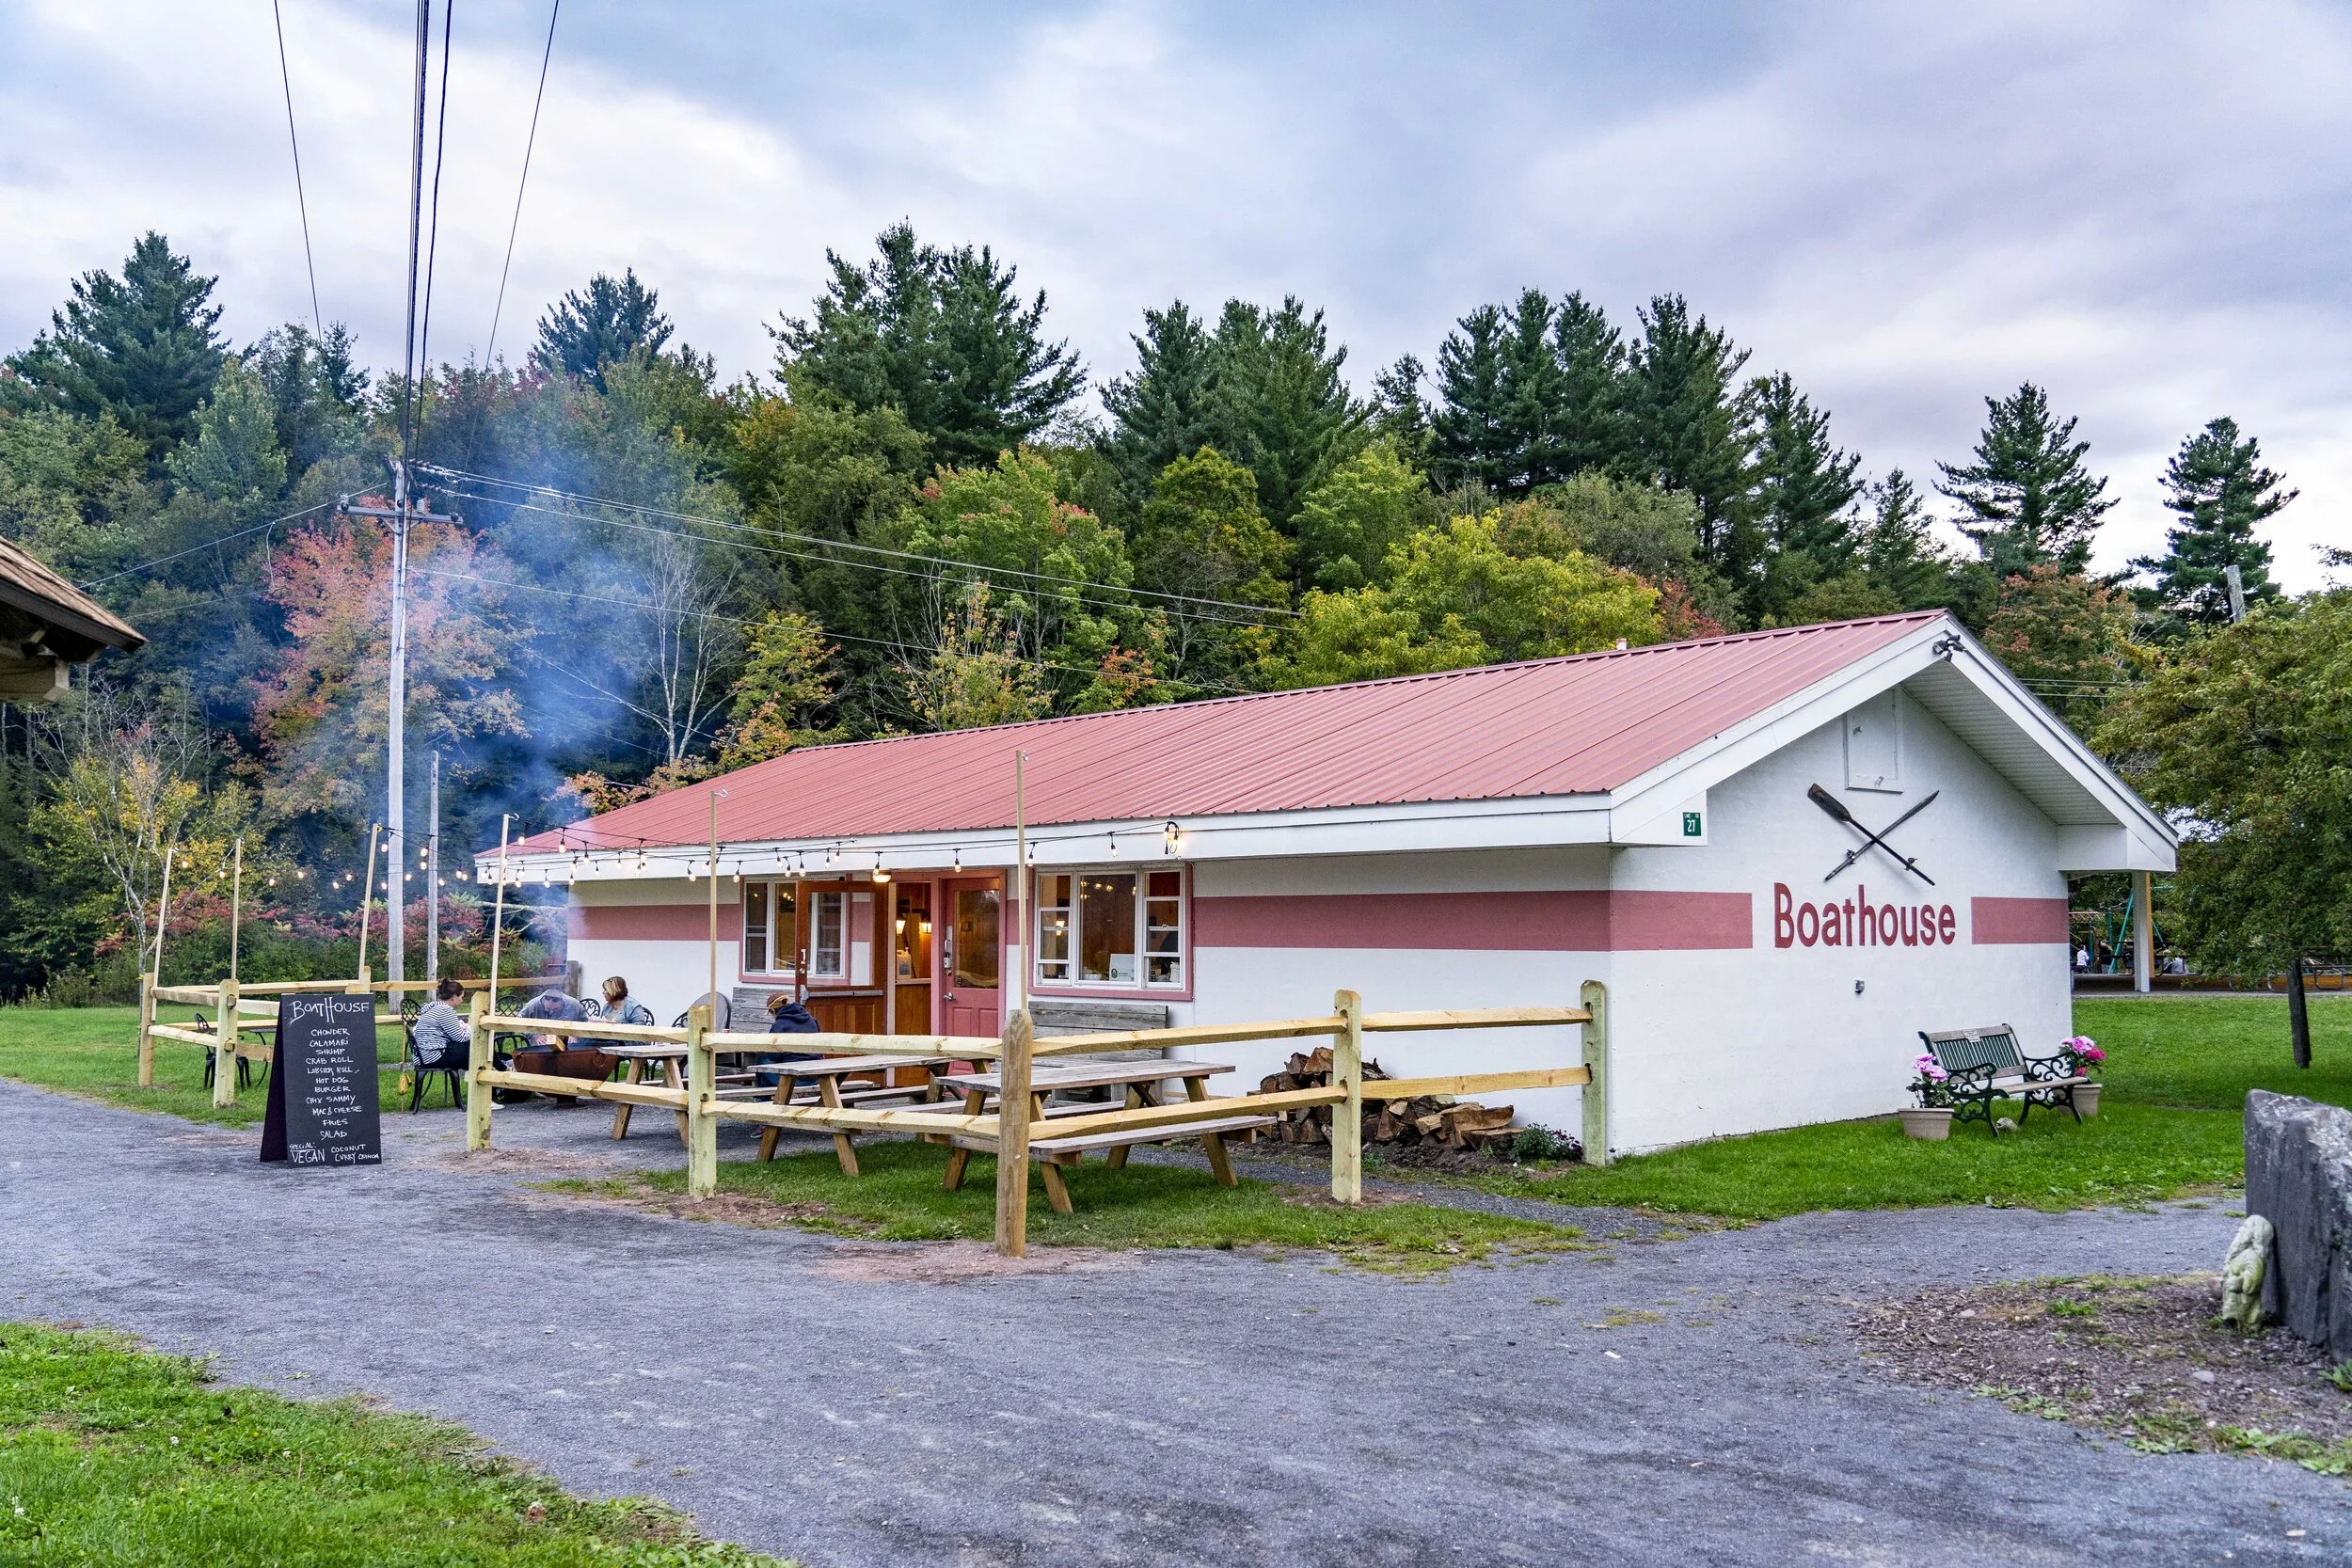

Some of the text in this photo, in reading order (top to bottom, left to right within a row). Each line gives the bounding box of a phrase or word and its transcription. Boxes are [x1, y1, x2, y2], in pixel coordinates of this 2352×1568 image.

[1687, 819, 1695, 832] 27
[1773, 882, 1956, 948] Boathouse
[310, 1028, 351, 1037] CHOWDER
[307, 1067, 334, 1076] LOBSTER
[326, 1094, 356, 1105] SAMMY
[333, 1105, 363, 1114] CHEESE
[320, 1130, 348, 1141] SALAD
[330, 1144, 366, 1153] COCONUT
[291, 1148, 326, 1164] VEGAN
[335, 1151, 357, 1164] CURRY
